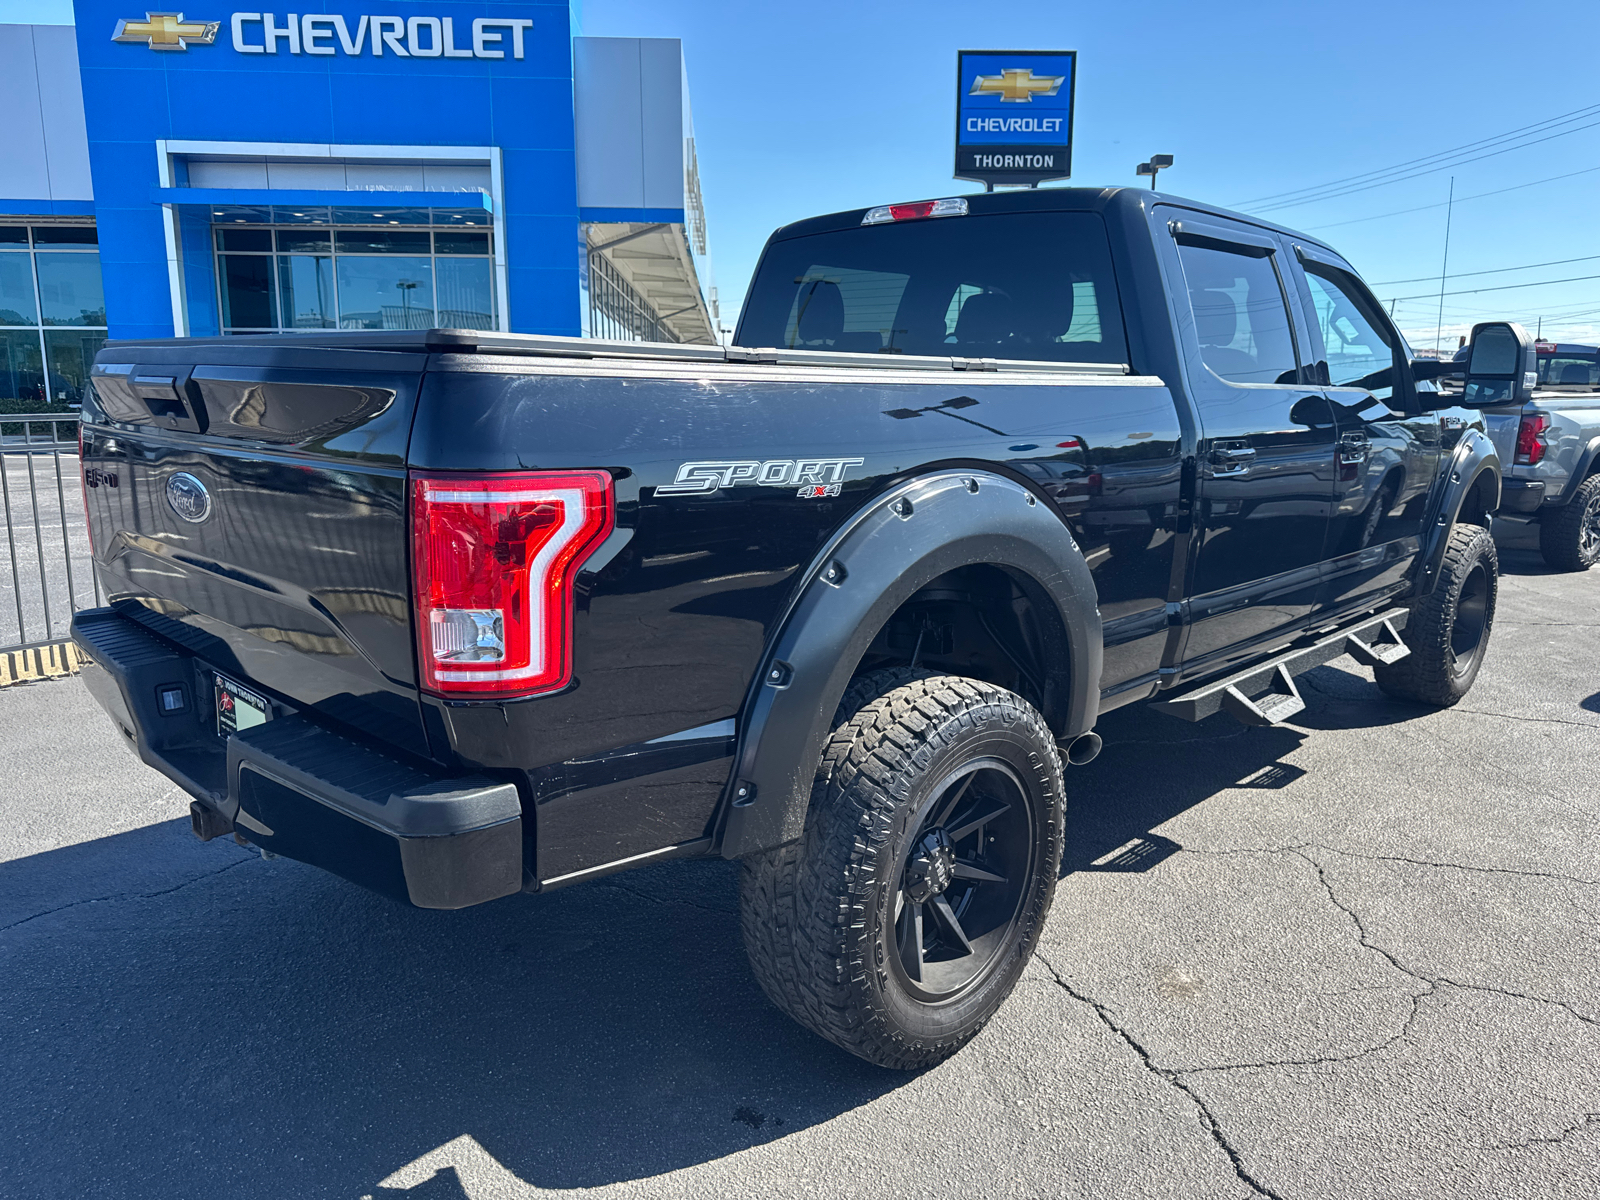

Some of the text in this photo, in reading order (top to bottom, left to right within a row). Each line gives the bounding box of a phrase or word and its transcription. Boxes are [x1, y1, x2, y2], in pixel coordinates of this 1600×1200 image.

[230, 12, 533, 59] CHEVROLET
[966, 117, 1063, 132] CHEVROLET
[973, 154, 1054, 168] THORNTON
[653, 457, 865, 497] SPORT
[171, 482, 197, 513] Ford
[238, 687, 265, 711] THORNTON
[1027, 751, 1055, 811] OPEN
